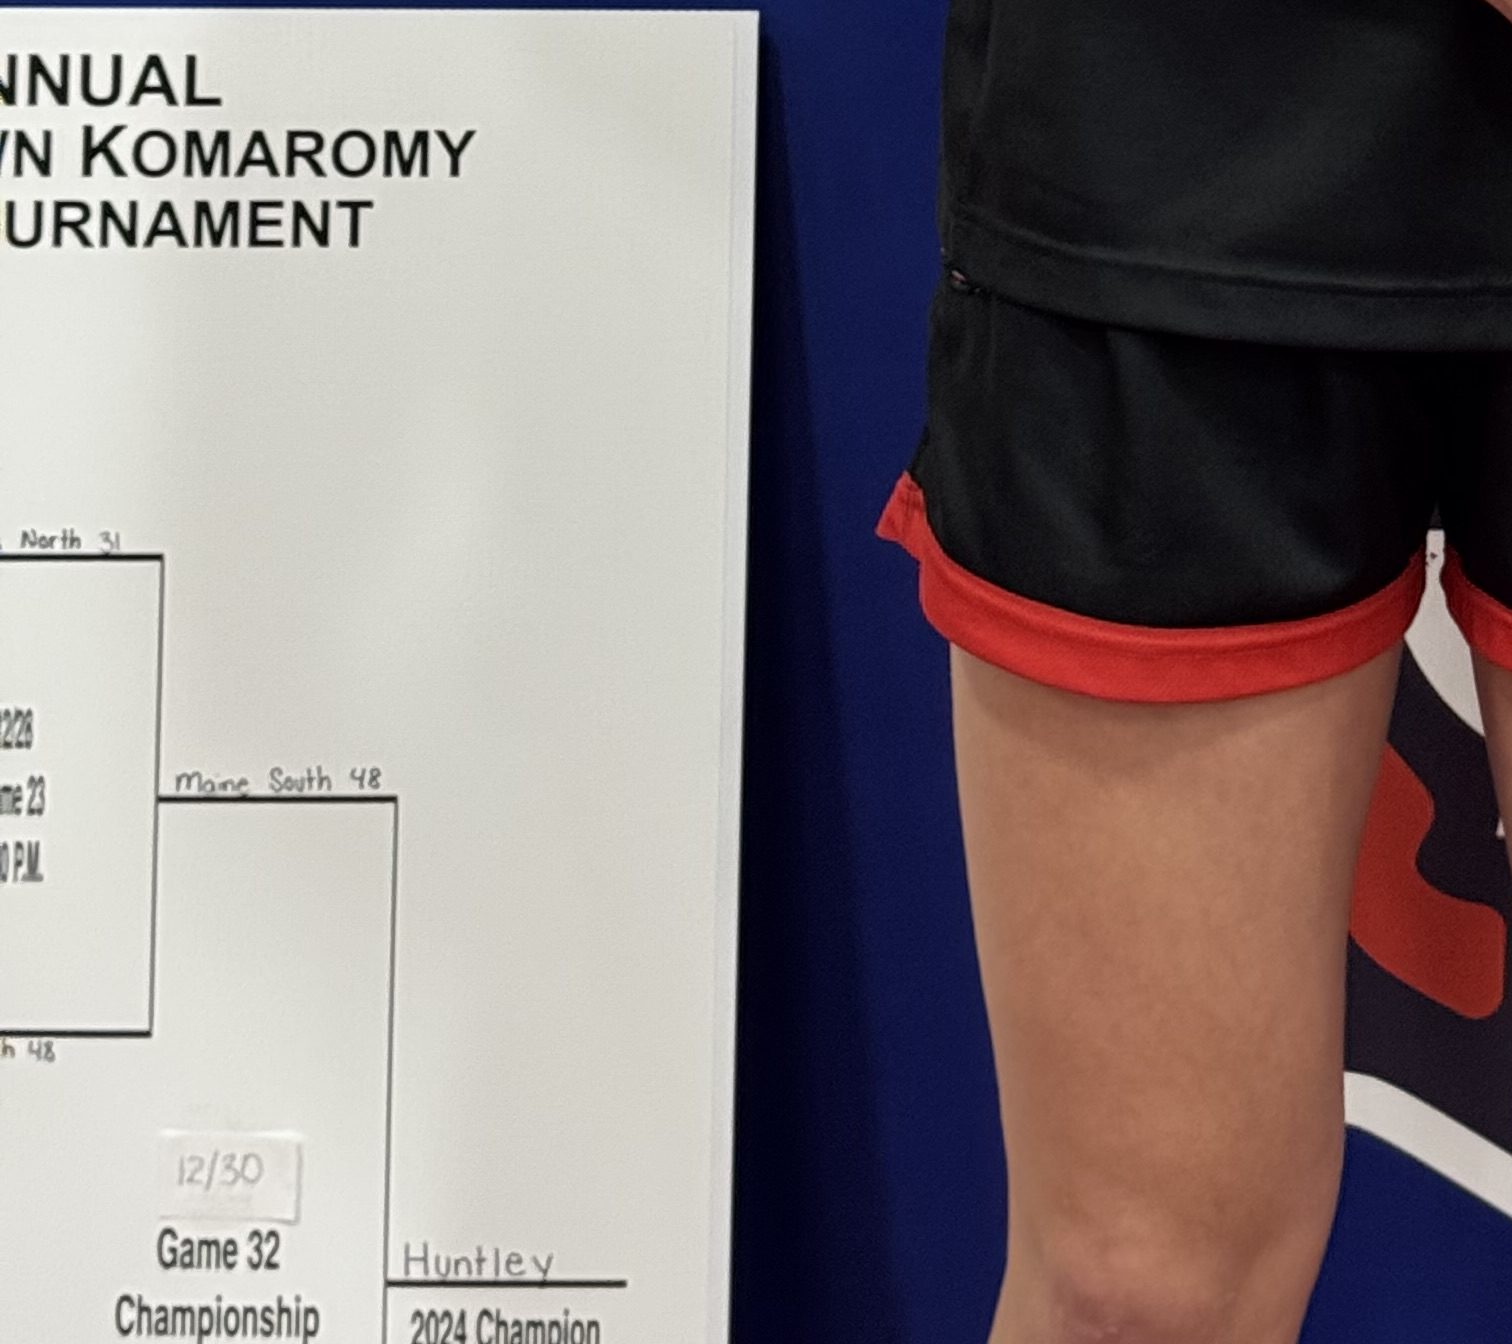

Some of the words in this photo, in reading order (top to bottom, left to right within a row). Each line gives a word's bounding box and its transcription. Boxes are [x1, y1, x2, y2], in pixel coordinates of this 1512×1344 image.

[81, 124, 477, 179] KOMAROMY
[20, 527, 82, 550] North
[268, 765, 332, 793] South
[350, 767, 382, 790] 48
[27, 1040, 56, 1062] 48
[177, 1150, 264, 1191] 12/30
[157, 1226, 238, 1269] Game
[247, 1229, 280, 1270] 32
[403, 1242, 554, 1288] Huntley
[115, 1294, 320, 1344] Championship
[410, 1309, 467, 1344] 2024
[475, 1308, 600, 1344] Champion
